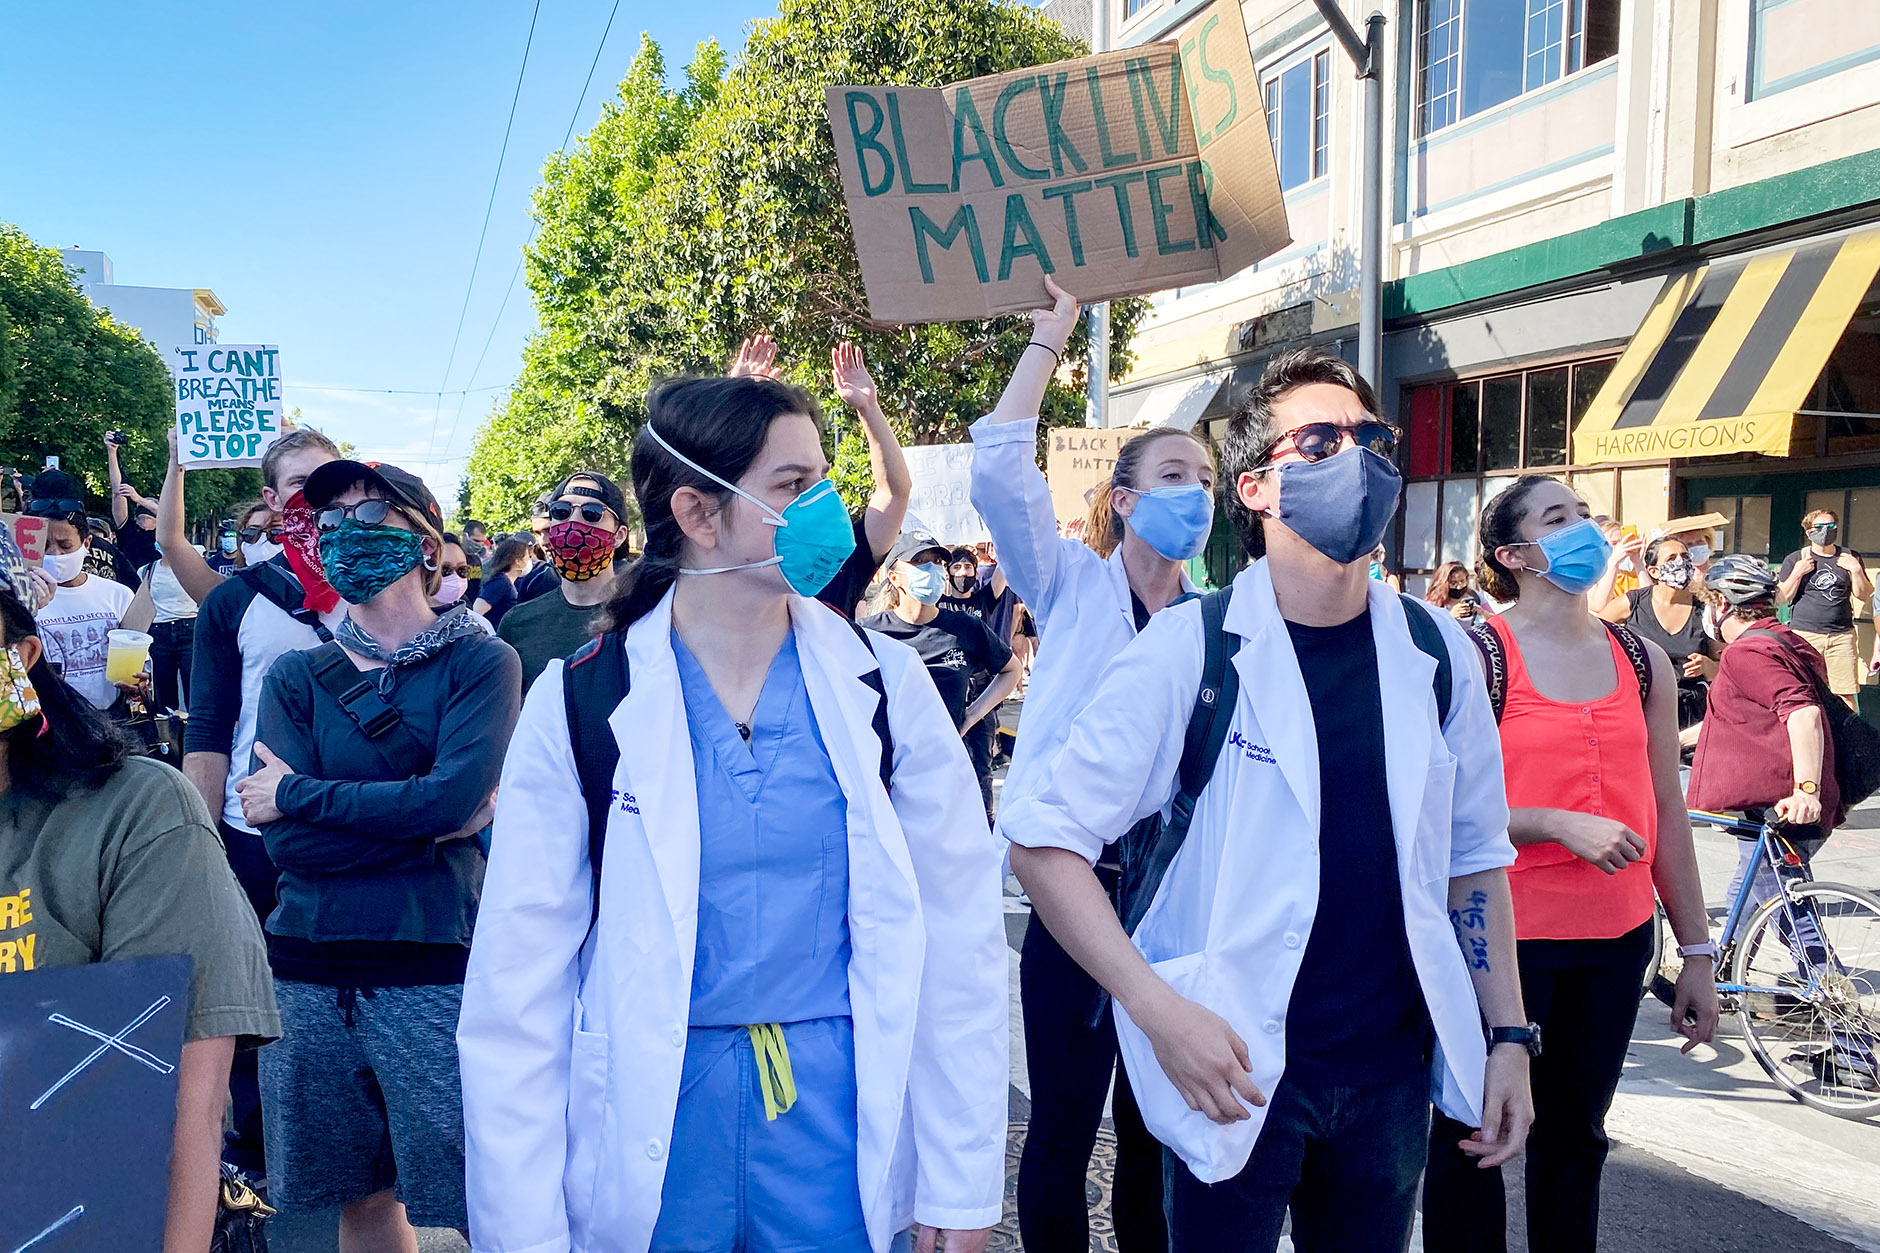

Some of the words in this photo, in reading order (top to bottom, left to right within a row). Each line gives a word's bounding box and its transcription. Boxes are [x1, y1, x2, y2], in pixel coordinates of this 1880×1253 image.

[845, 72, 1088, 198] BLACK
[1087, 14, 1238, 168] LIVES
[908, 159, 1229, 284] MATTER
[178, 377, 280, 402] BREATHE
[207, 398, 255, 410] MEANS
[180, 409, 276, 435] PLEASE
[189, 433, 262, 459] STOP
[1055, 435, 1107, 452] BLACK
[1595, 421, 1756, 457] HARRINGTON'S
[36, 613, 85, 626] HOMELAND
[1246, 750, 1277, 765] Medicine
[1247, 742, 1271, 755] School
